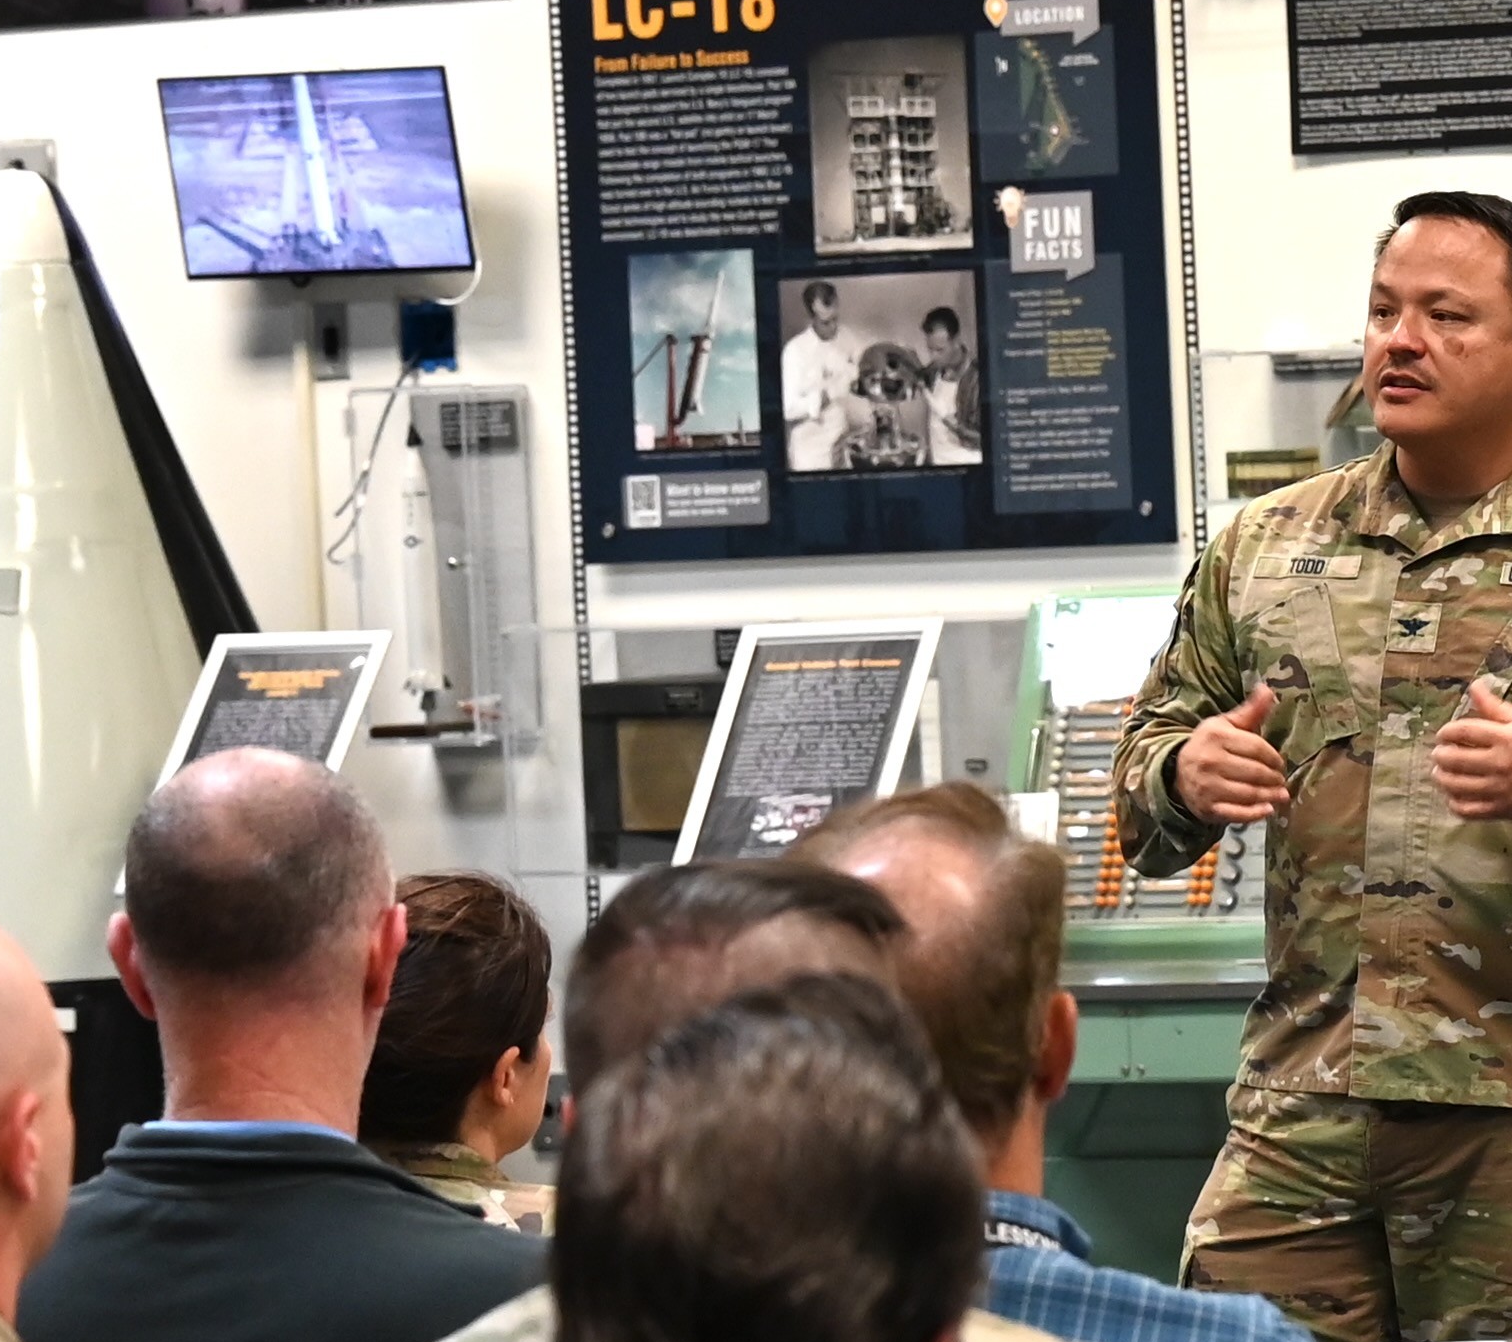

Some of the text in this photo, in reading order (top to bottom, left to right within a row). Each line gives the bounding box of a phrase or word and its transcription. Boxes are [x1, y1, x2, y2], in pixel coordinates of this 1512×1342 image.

[1014, 5, 1085, 26] LOCATION
[1025, 206, 1082, 239] FUN
[1025, 239, 1083, 261] FACTS
[1289, 558, 1326, 575] TODD
